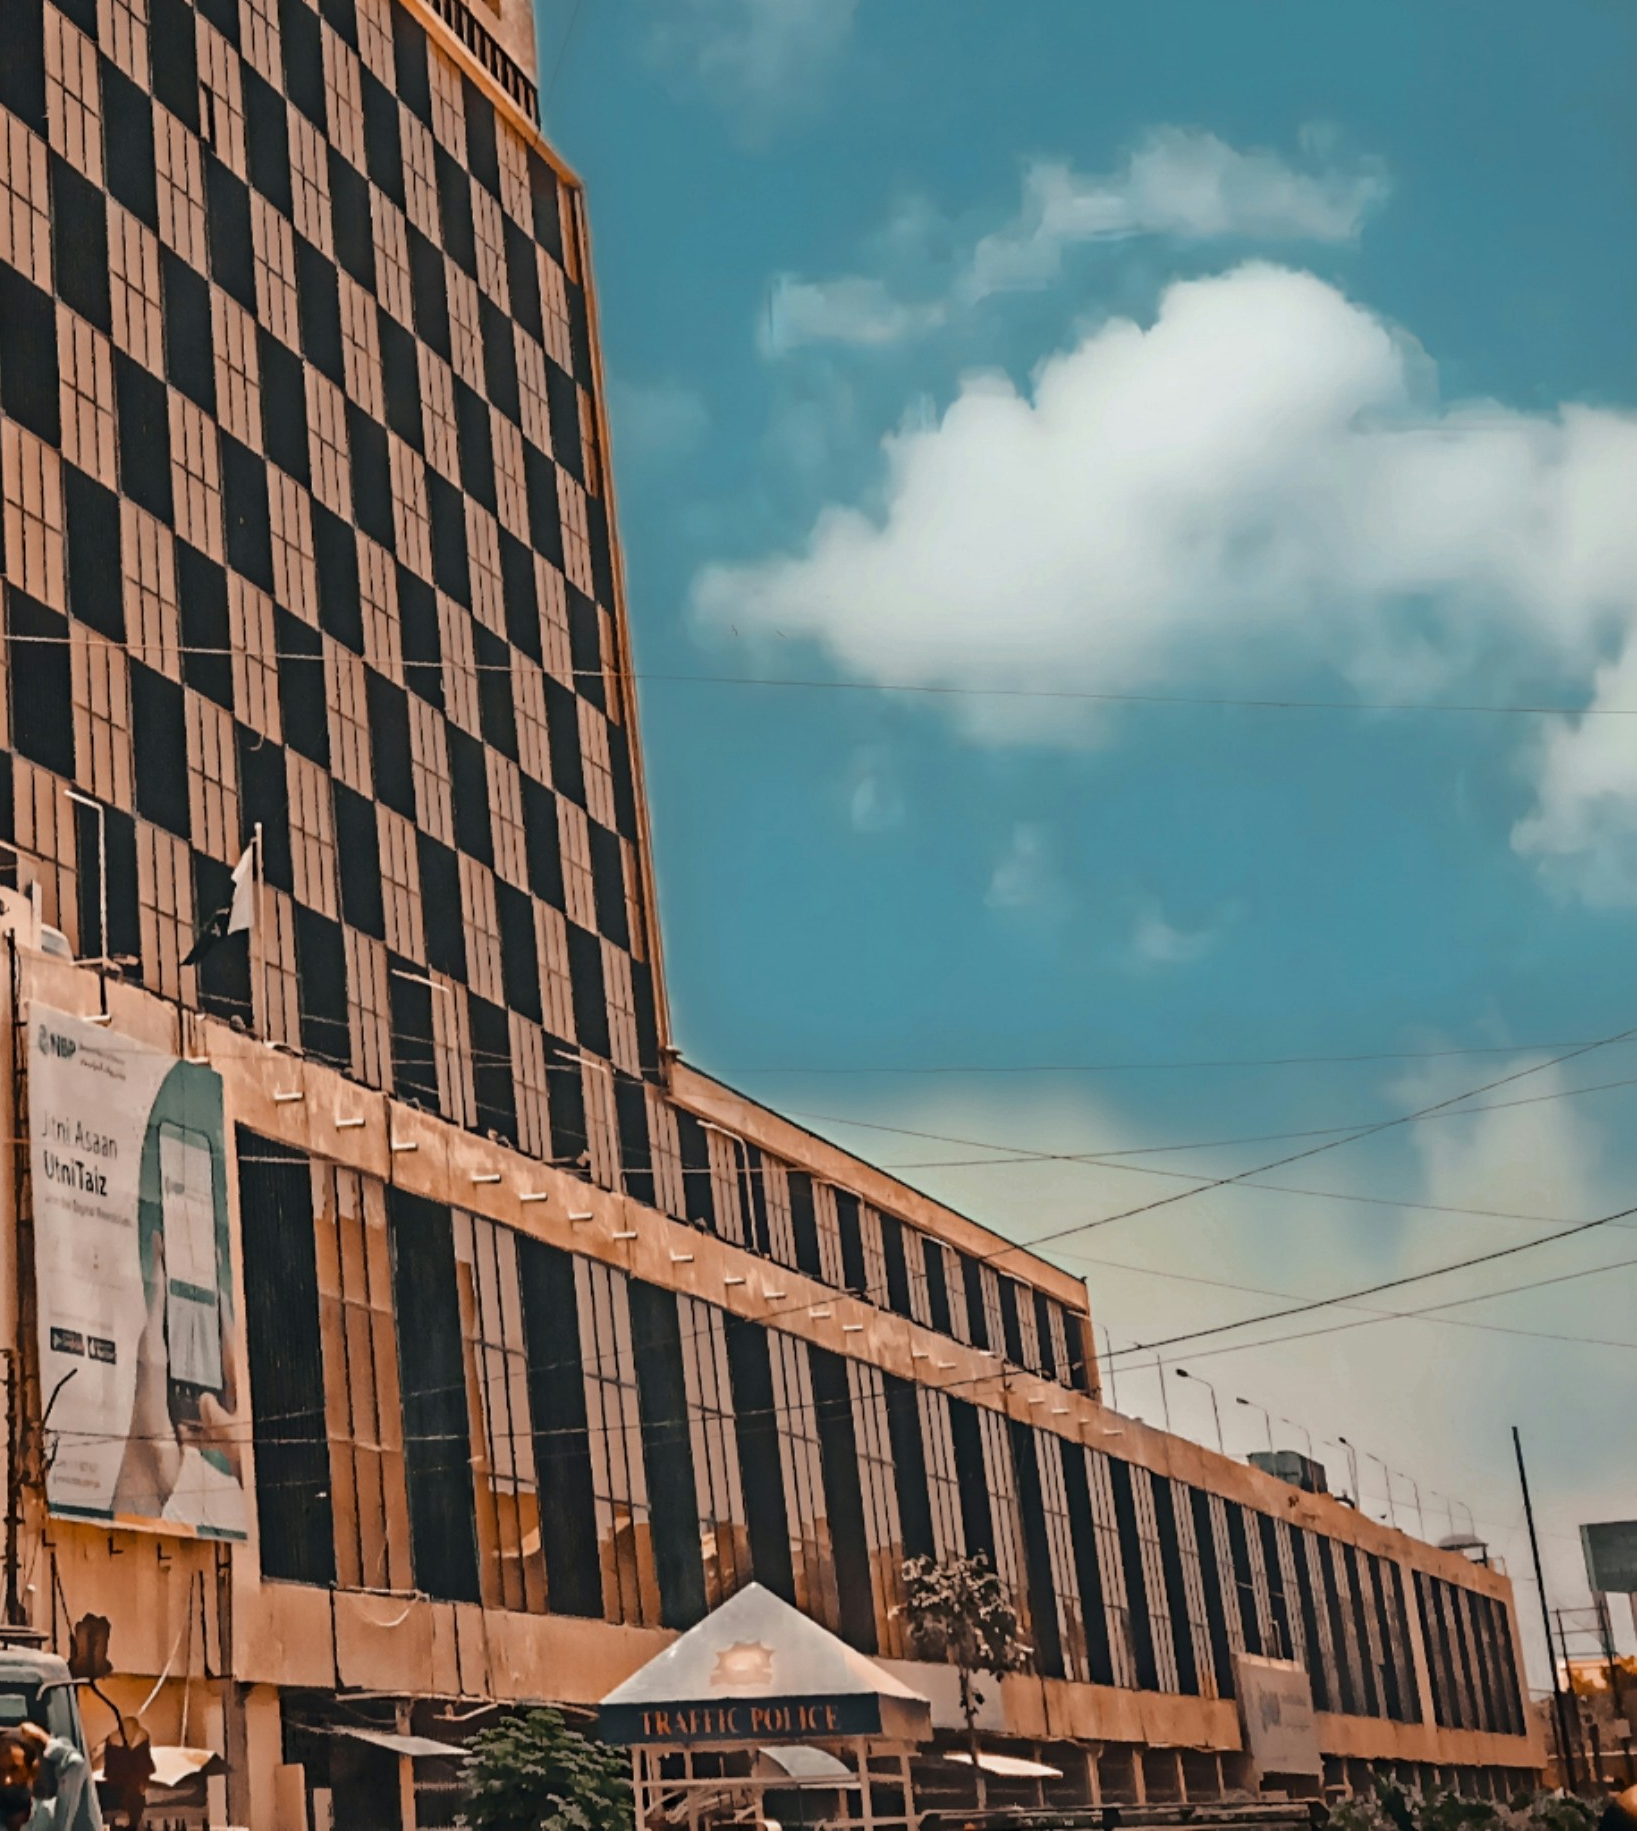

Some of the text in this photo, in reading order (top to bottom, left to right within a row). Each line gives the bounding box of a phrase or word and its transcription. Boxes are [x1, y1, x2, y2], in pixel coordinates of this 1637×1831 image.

[41, 1110, 118, 1160] Jtni Asaan
[42, 1148, 108, 1197] UtniTaiz
[639, 1703, 841, 1736] TRAFFIC POLICE
